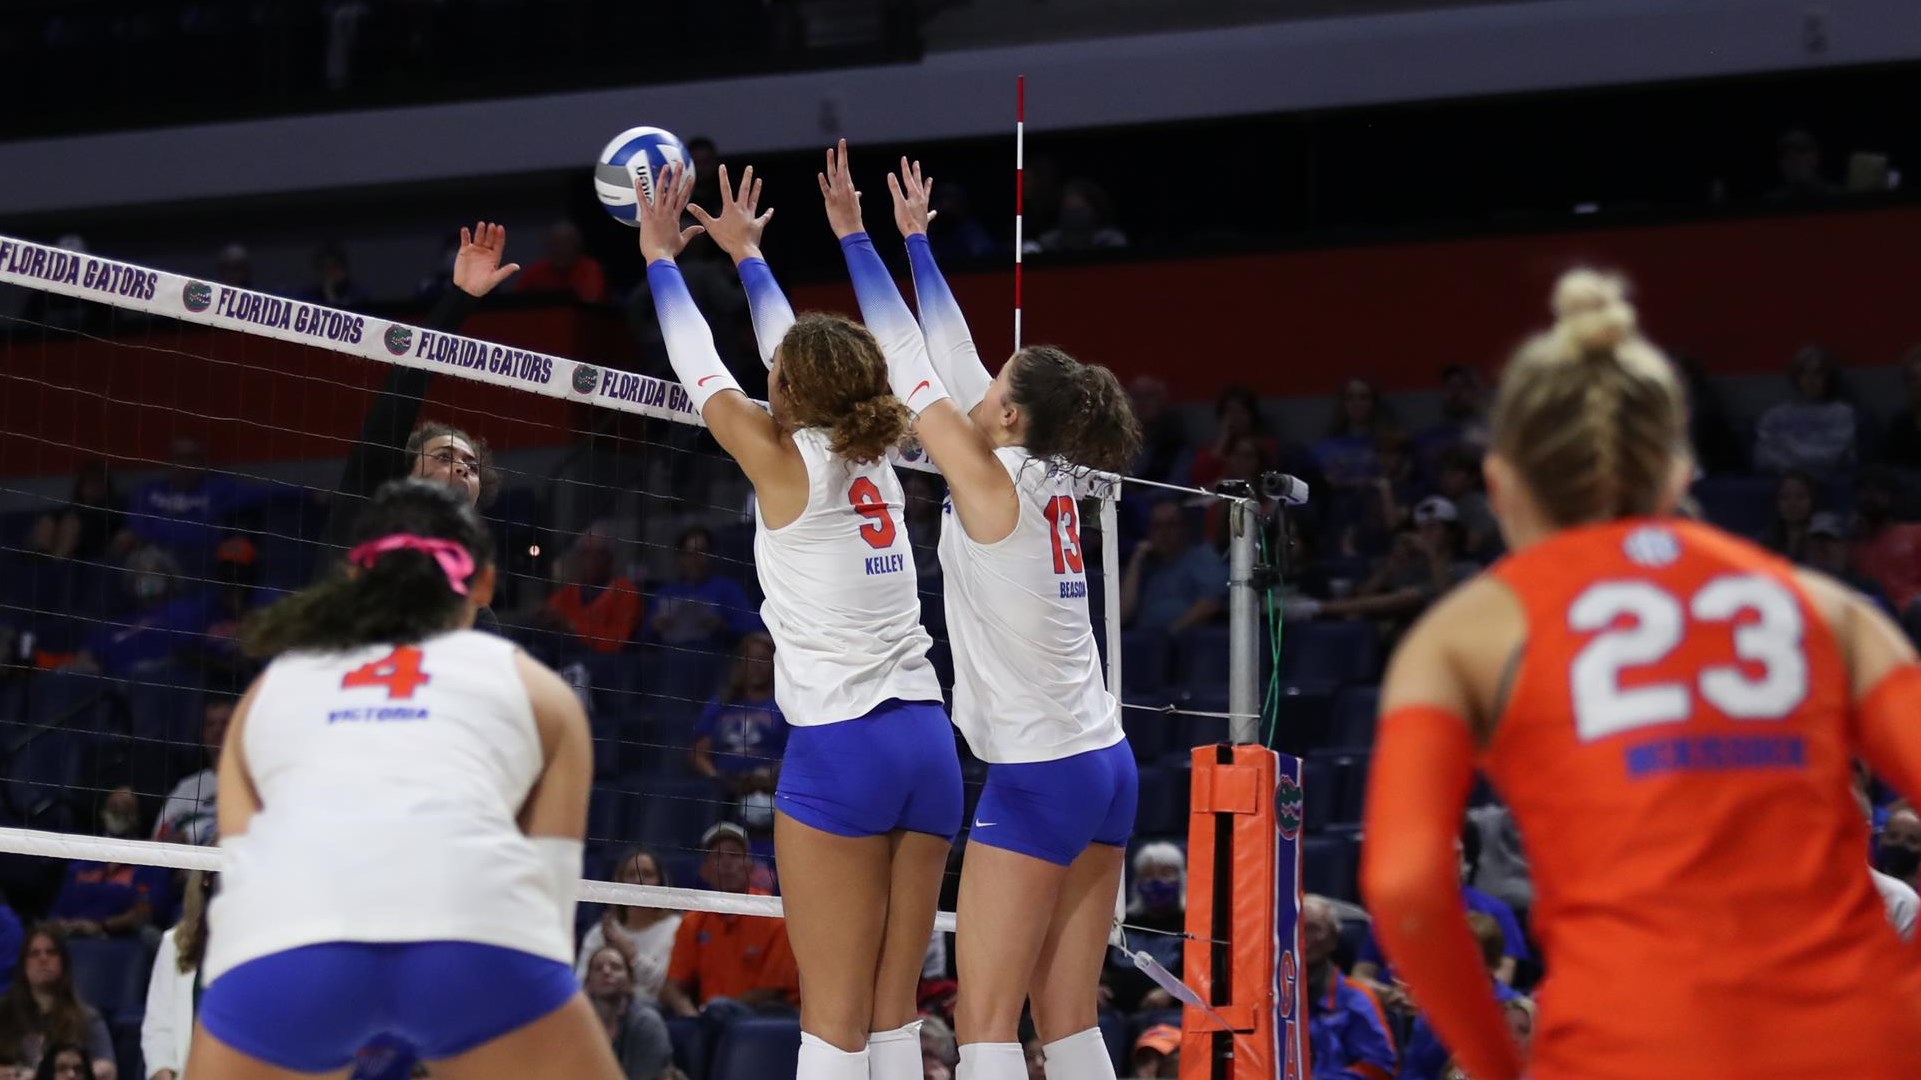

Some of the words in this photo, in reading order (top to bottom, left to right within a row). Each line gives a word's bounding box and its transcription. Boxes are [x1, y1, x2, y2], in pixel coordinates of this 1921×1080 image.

[0, 241, 78, 286] FLORIDA
[84, 257, 158, 301] GATORS
[215, 287, 290, 330] FLORIDA
[294, 304, 364, 344] GATORS
[416, 331, 487, 371] FLORIDA
[489, 346, 553, 385] GATORS
[600, 370, 666, 407] FLORIDA
[668, 384, 700, 415] GA
[848, 476, 896, 549] 9
[1043, 495, 1083, 574] 13
[865, 553, 904, 576] KELLEY
[1060, 581, 1086, 598] BEASON
[341, 644, 431, 699] 4
[1568, 574, 1808, 741] 23
